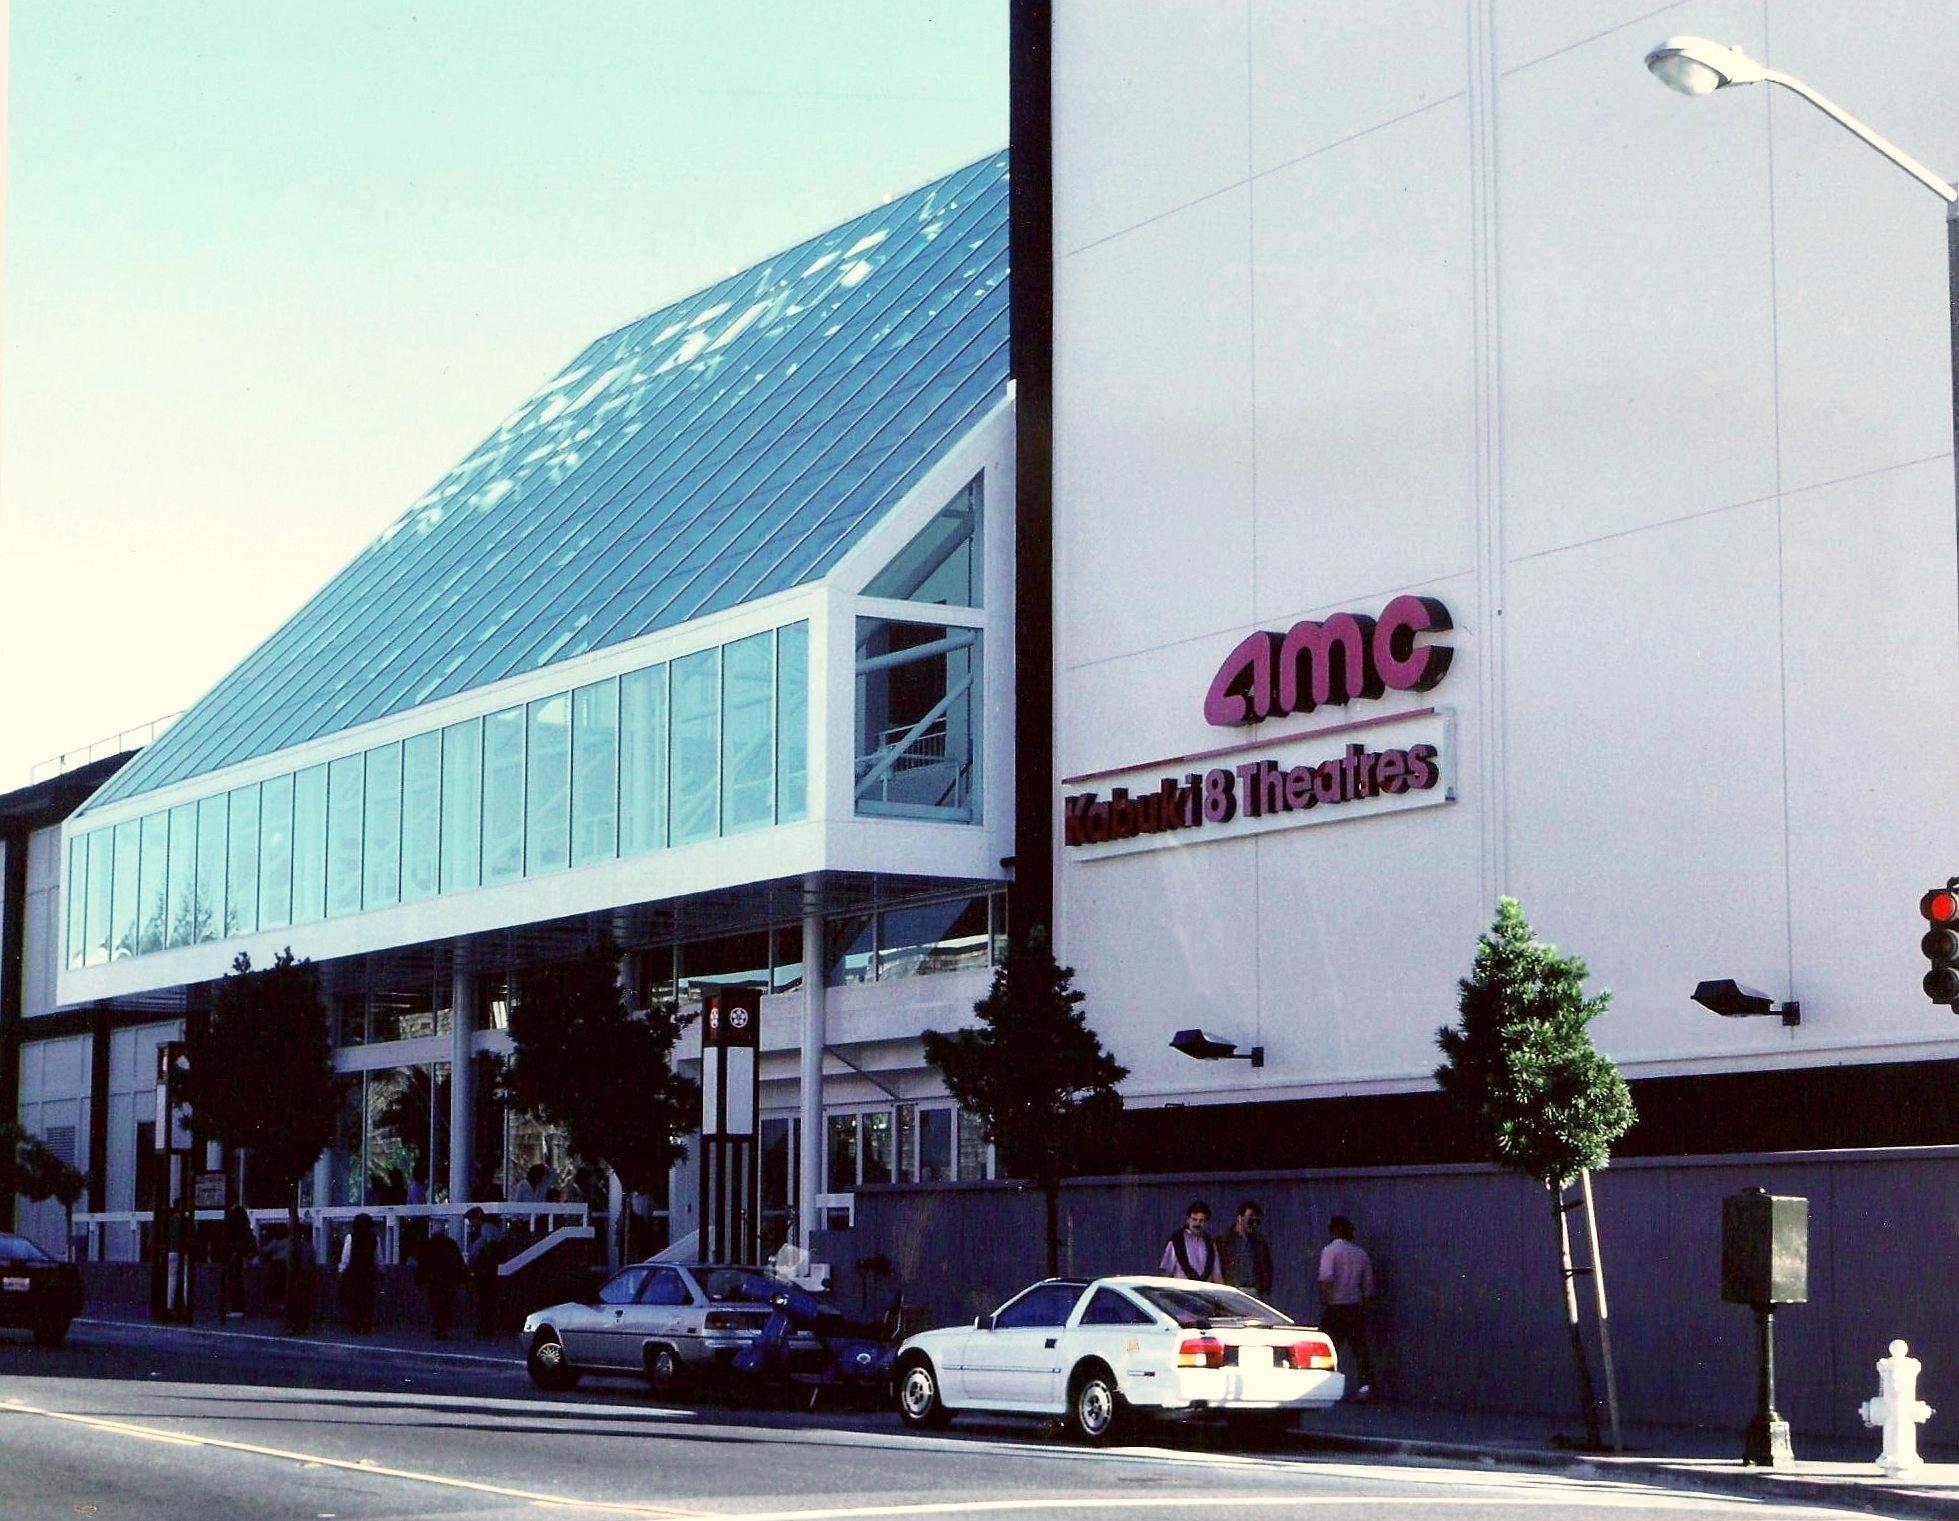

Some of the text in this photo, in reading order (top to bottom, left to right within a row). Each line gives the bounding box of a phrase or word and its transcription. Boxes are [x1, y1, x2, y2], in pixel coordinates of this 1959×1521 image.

[1065, 743, 1440, 846] Kabuki 8 Theatres
